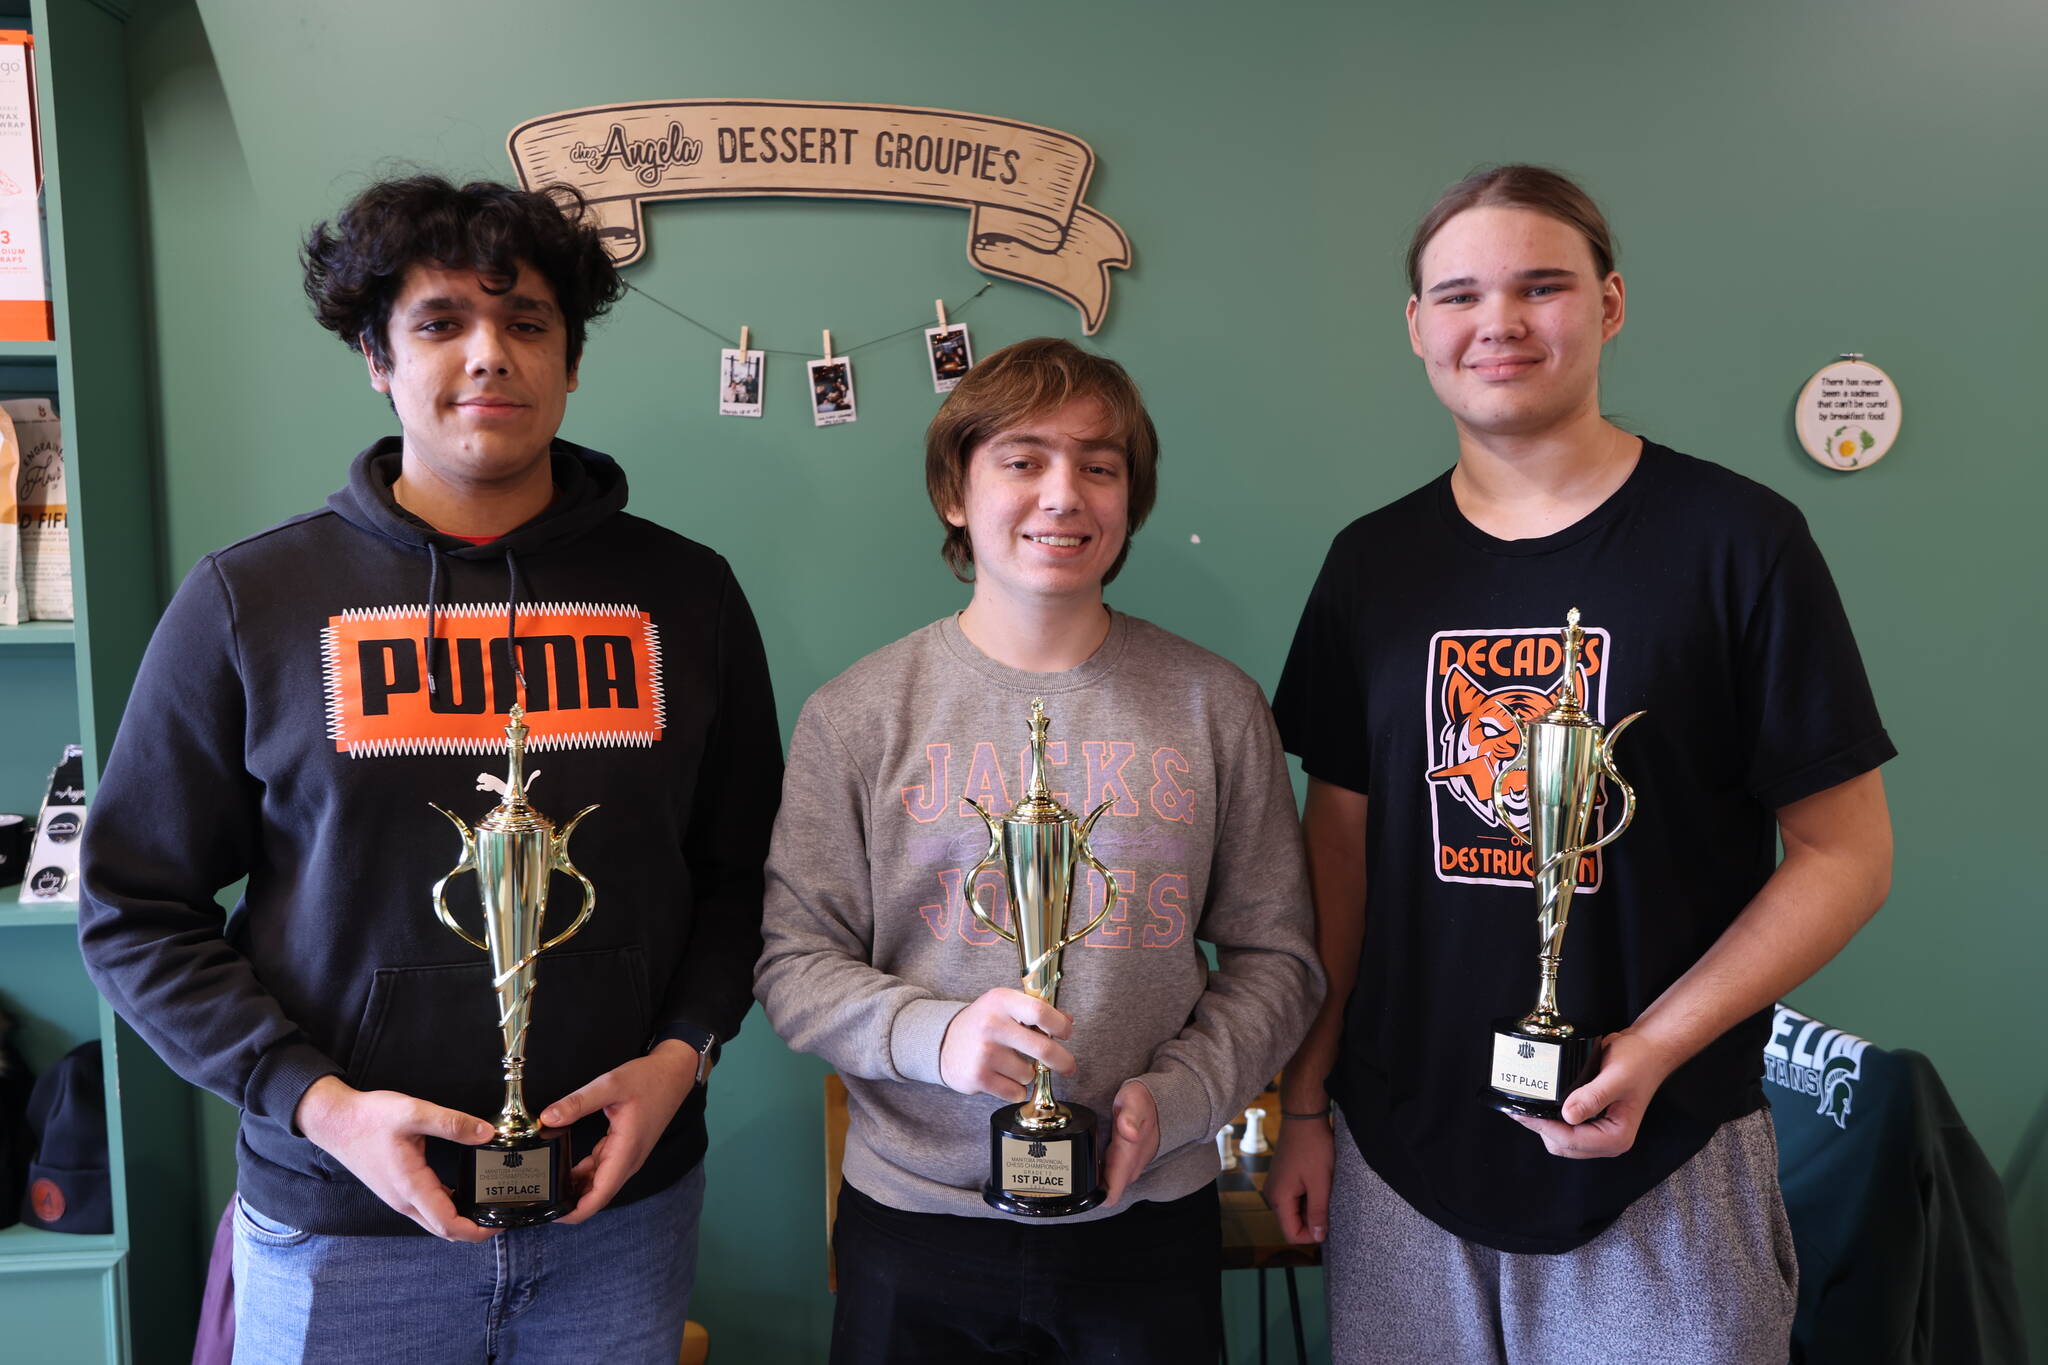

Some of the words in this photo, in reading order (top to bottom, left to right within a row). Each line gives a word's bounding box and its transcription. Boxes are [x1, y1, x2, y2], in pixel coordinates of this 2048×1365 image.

[571, 142, 598, 167] chez
[596, 123, 701, 186] Angela
[717, 127, 859, 165] DESSERT
[875, 131, 1021, 185] GROUPIES
[1822, 378, 1843, 386] There
[1846, 378, 1859, 386] has
[1819, 413, 1827, 421] by
[1830, 412, 1865, 420] breakfast
[1865, 400, 1887, 408] cured
[1439, 637, 1601, 676] DECADS
[358, 634, 639, 716] PUMA
[1441, 845, 1595, 883] DESTRUCN
[919, 868, 1191, 949] JOES
[1500, 1073, 1518, 1083] 1ST
[1520, 1077, 1549, 1090] PLACE
[1763, 1055, 1822, 1096] TANS
[485, 1186, 504, 1195] 1ST
[507, 1184, 540, 1195] PLACE
[1012, 1174, 1030, 1183] 1ST
[1032, 1176, 1064, 1186] PLACE
